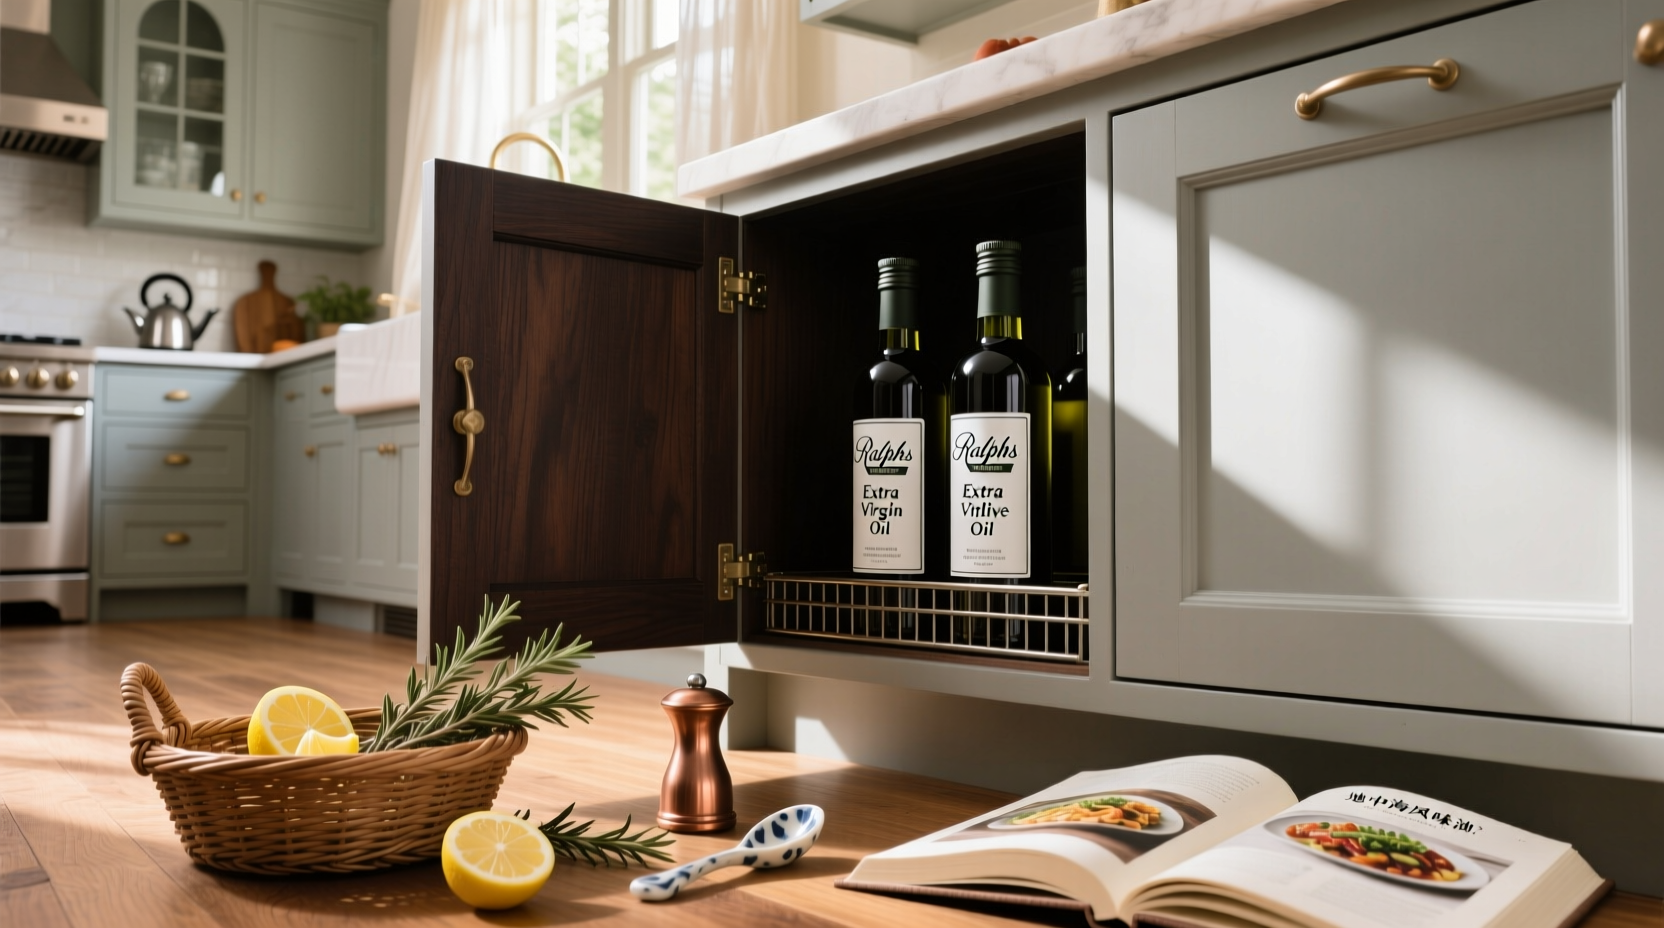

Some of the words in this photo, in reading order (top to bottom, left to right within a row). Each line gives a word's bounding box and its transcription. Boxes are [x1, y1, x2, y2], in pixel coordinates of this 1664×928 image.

[854, 436, 913, 467] Ralphs
[952, 431, 1018, 465] Ralphs
[863, 485, 899, 499] Extra
[962, 484, 1004, 498] Extra
[861, 502, 902, 521] Virgin
[870, 521, 890, 535] Oil
[970, 521, 994, 536] Oil
